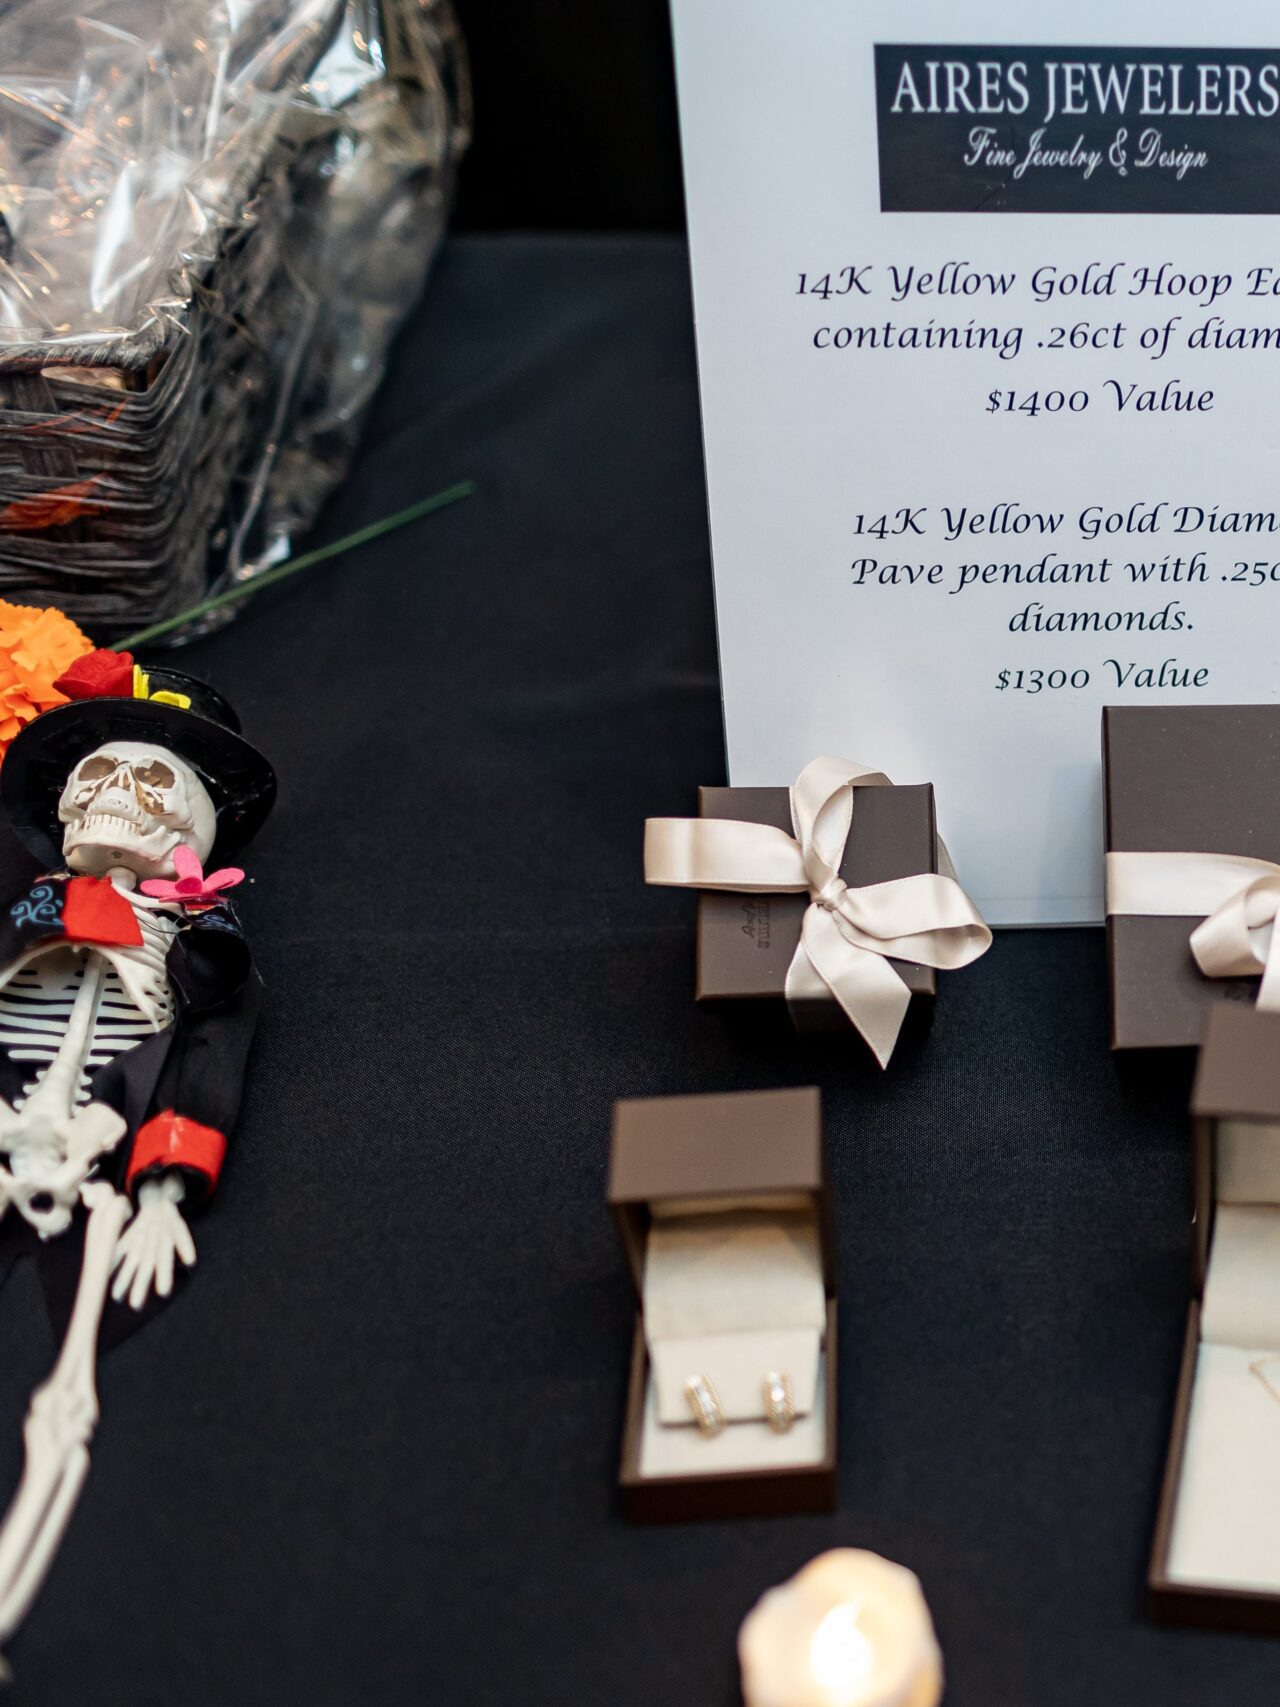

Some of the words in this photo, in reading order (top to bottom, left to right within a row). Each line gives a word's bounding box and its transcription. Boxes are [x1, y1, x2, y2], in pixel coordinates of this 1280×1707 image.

[890, 60, 1030, 115] AIRES
[1043, 62, 1280, 123] JEWELERS
[963, 125, 1017, 167] Fine
[1012, 127, 1103, 180] Jewelry
[1108, 127, 1129, 177] &
[1133, 127, 1208, 180] Design
[795, 266, 873, 301] 14K
[887, 261, 1017, 303] Yellow
[1031, 261, 1126, 303] Gold
[1127, 262, 1233, 308] Hoop
[813, 318, 1024, 361] containing
[1036, 321, 1127, 350] .26ct
[1139, 316, 1183, 361] of
[984, 388, 1090, 417] $1400
[1102, 379, 1214, 412] Value
[852, 507, 928, 540] 14K
[940, 502, 1065, 542] Yellow
[1078, 502, 1170, 541] Gold
[850, 558, 944, 585] Pave
[947, 552, 1113, 595] pendant
[1123, 551, 1210, 583] with
[1008, 600, 1194, 633] diamonds.
[994, 668, 1090, 694] $1300
[1102, 658, 1209, 689] Value
